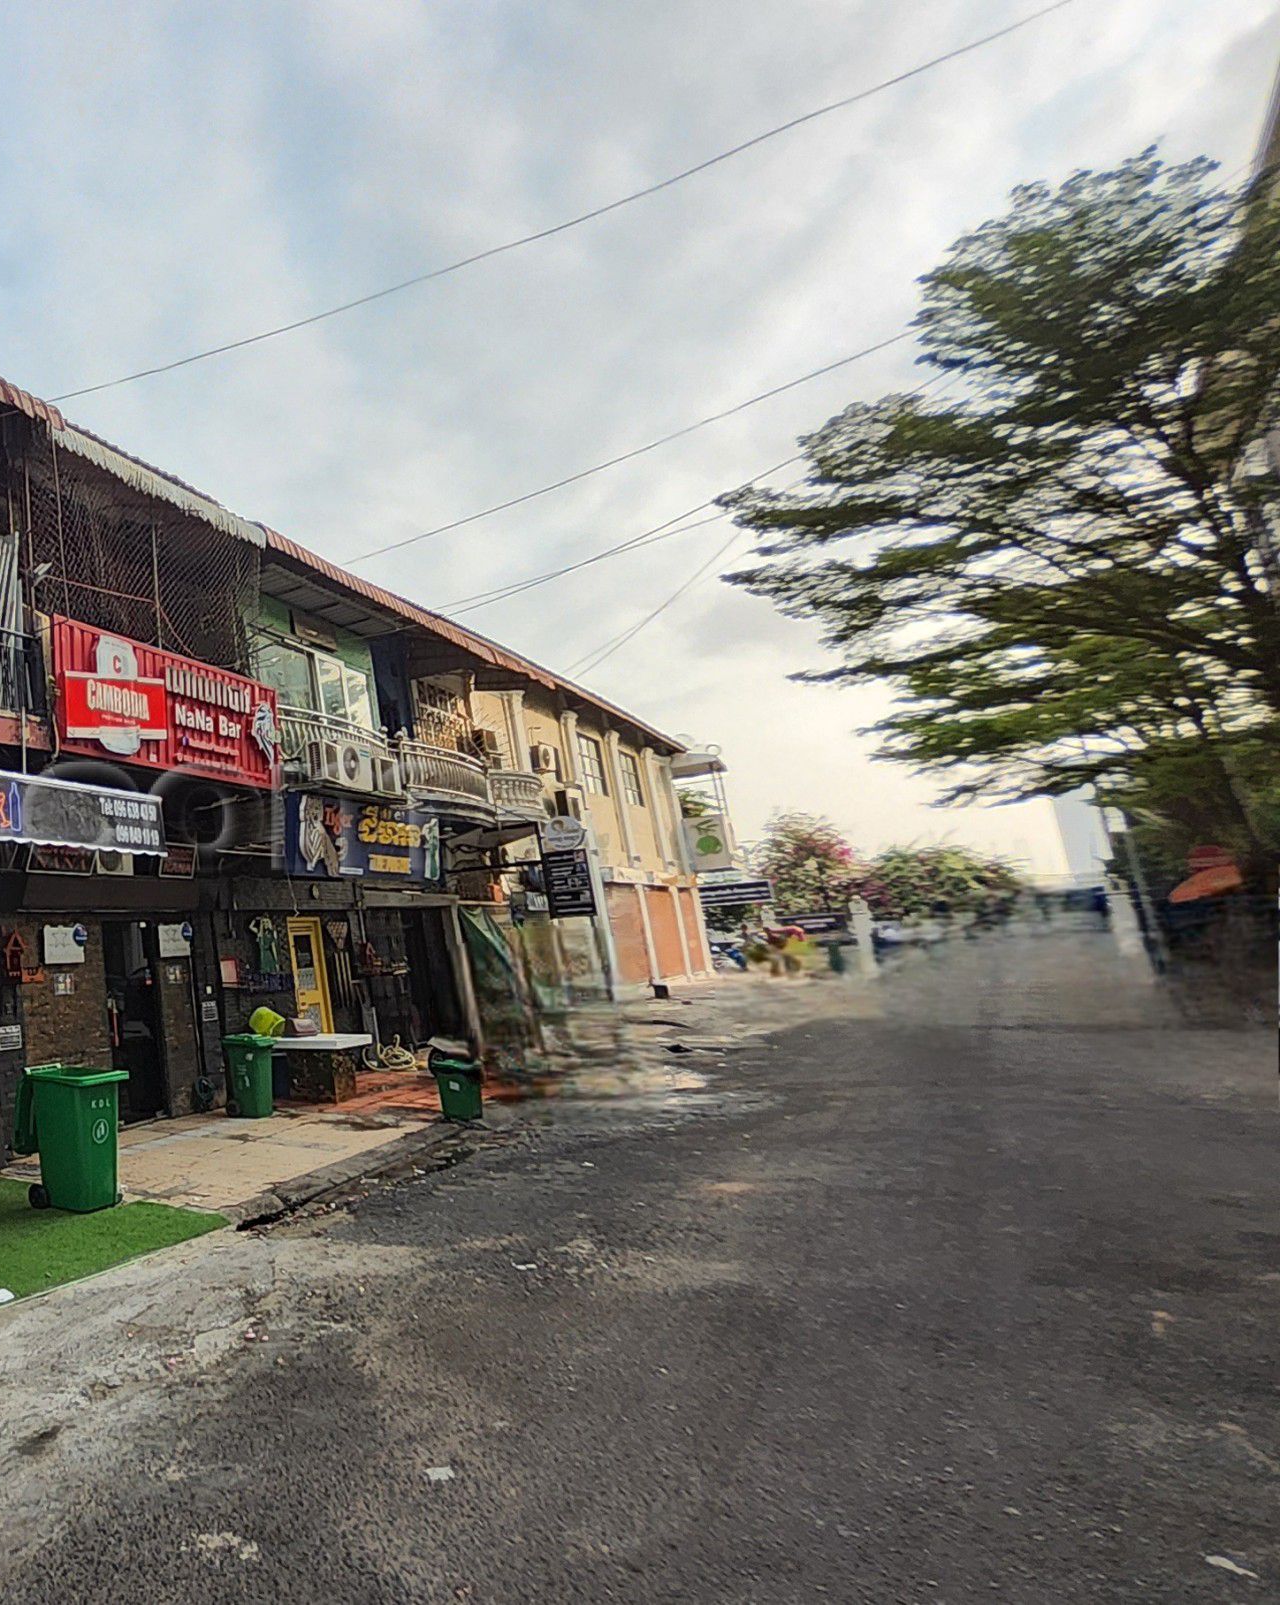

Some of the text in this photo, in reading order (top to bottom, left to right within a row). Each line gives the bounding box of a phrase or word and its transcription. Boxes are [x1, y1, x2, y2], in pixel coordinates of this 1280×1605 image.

[86, 678, 150, 721] CAMBODIA
[175, 702, 241, 739] NaNa Bar
